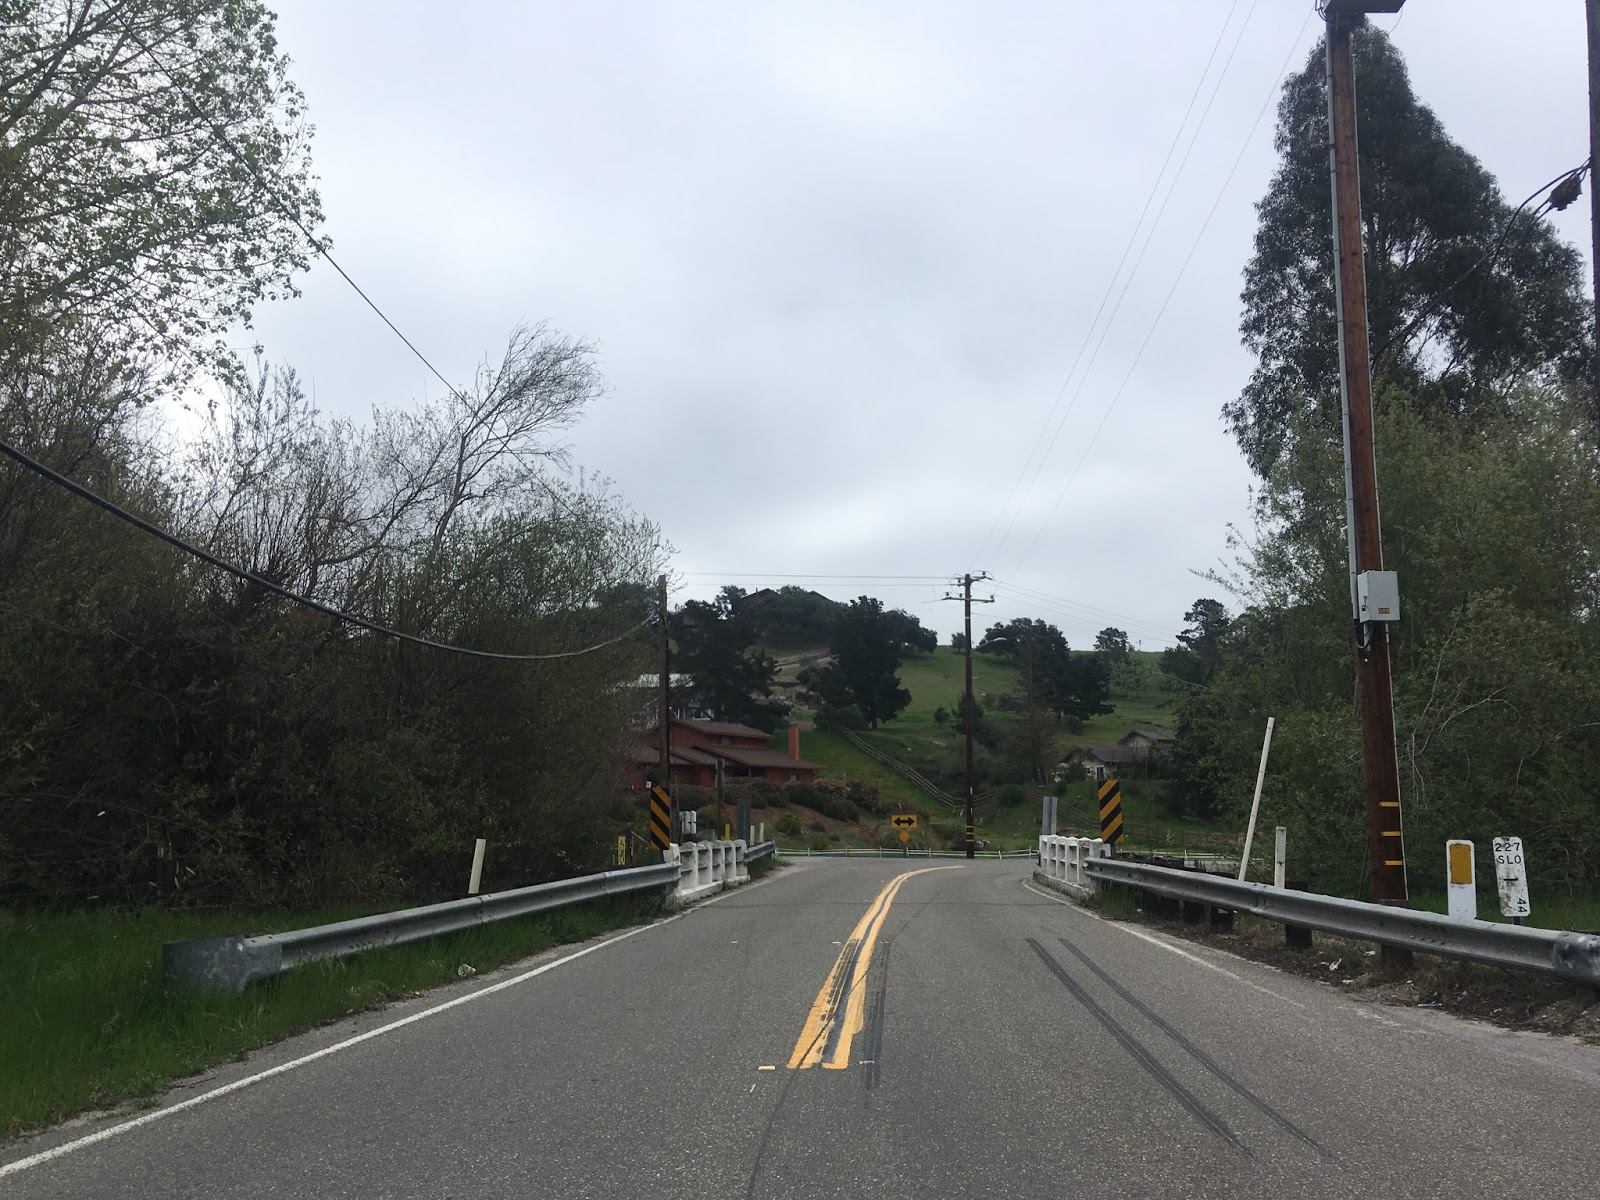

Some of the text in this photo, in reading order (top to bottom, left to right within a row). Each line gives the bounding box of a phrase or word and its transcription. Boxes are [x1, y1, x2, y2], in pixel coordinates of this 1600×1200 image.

[1494, 842, 1521, 852] 227
[1498, 855, 1522, 865] SLO
[1517, 898, 1528, 913] 44
